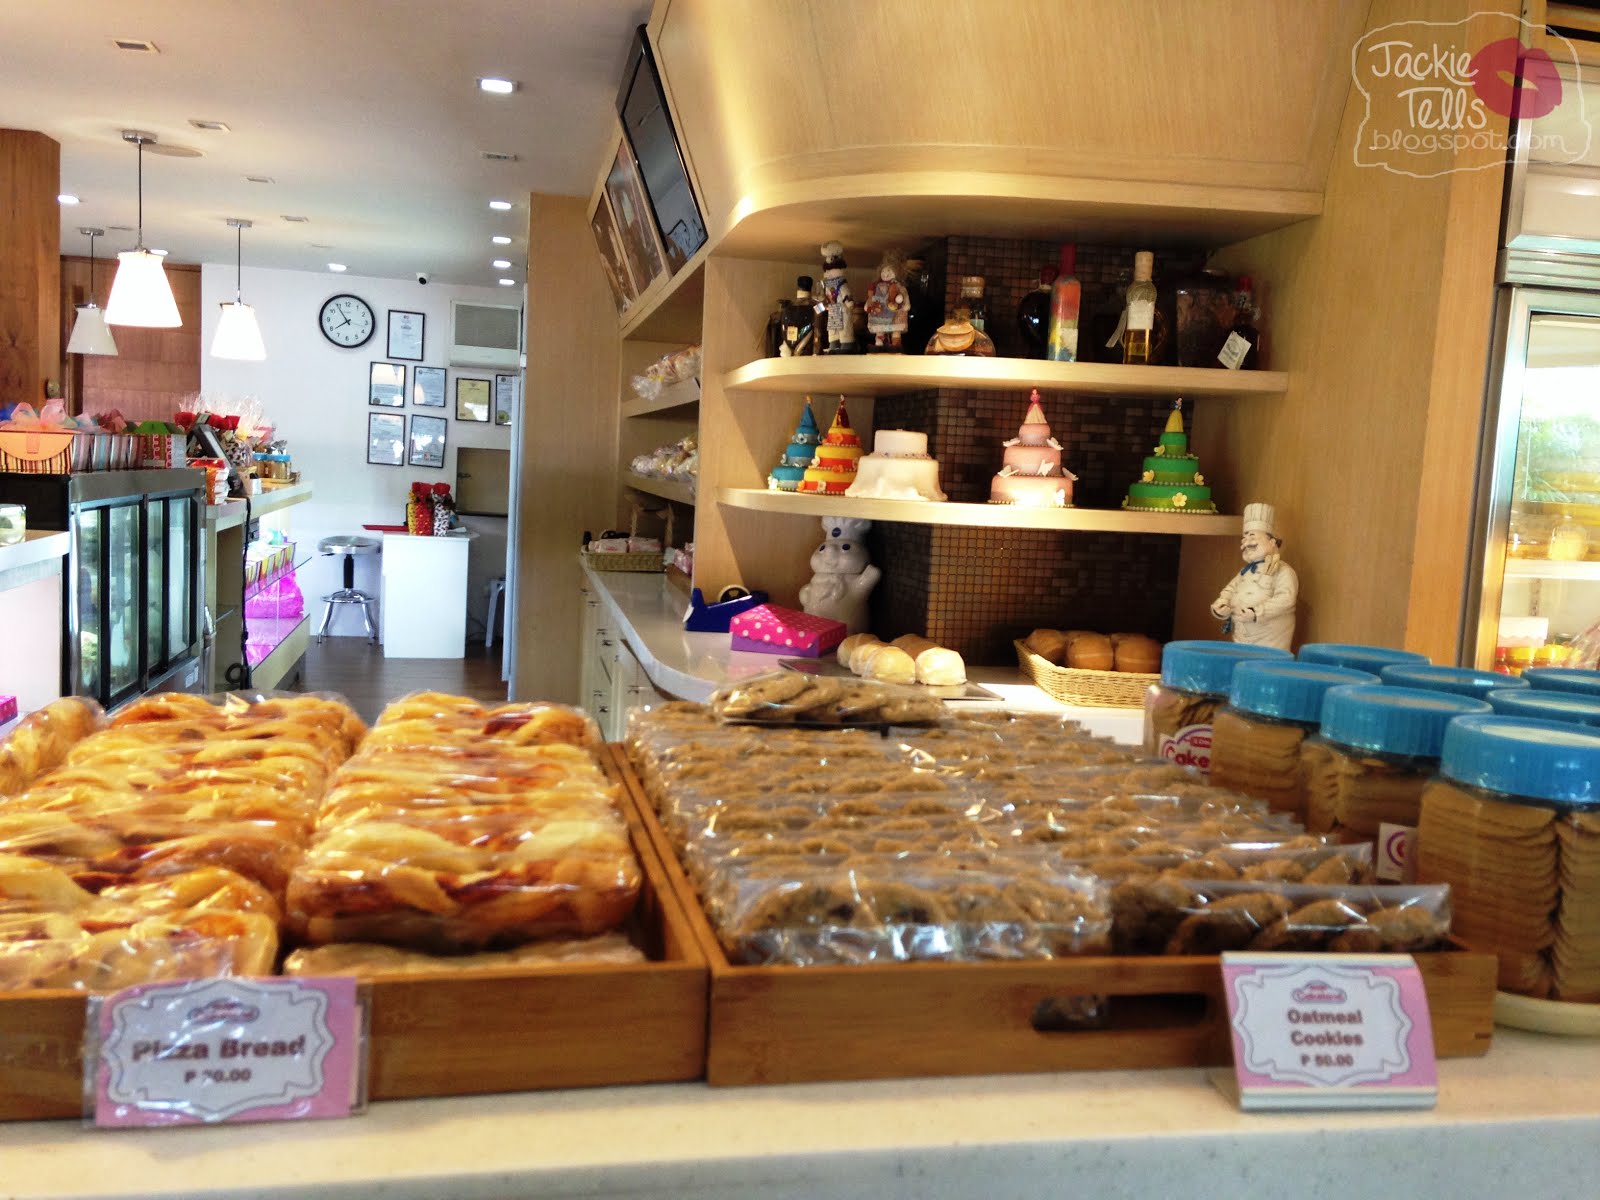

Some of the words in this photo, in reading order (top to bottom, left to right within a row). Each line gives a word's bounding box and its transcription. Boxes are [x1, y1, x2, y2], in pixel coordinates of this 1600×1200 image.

[1287, 1008, 1363, 1024] Oatmeal
[1290, 1030, 1364, 1047] Cookies
[219, 1035, 306, 1060] Bread
